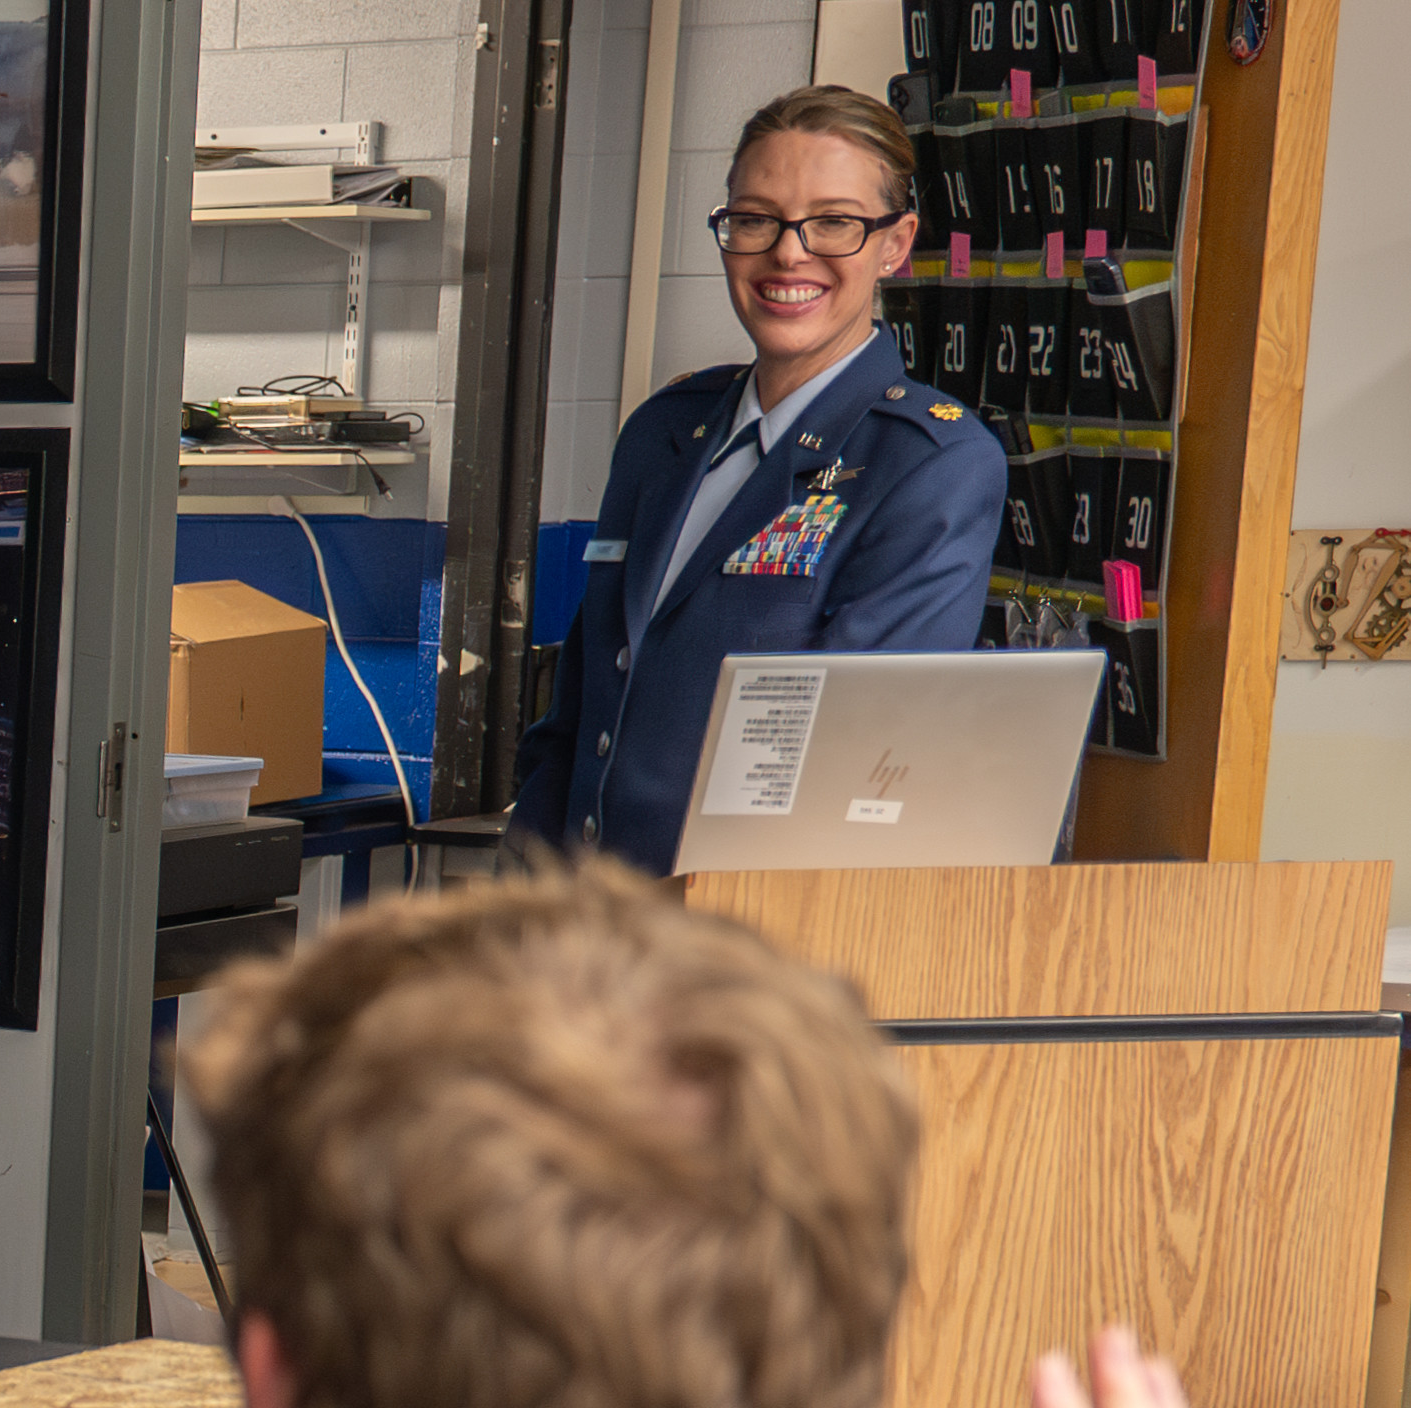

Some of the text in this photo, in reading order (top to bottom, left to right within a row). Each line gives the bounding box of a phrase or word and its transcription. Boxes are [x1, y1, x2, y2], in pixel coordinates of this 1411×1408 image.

[971, 1, 996, 52] 08
[1012, 0, 1038, 50] 09
[943, 171, 971, 219] 14
[1044, 163, 1065, 214] 16
[1095, 157, 1113, 209] 17
[1135, 158, 1155, 214] 18
[944, 322, 966, 373] 20
[996, 323, 1017, 373] 21
[1029, 324, 1056, 376] 22
[1079, 326, 1103, 379] 23
[1125, 496, 1152, 549] 30
